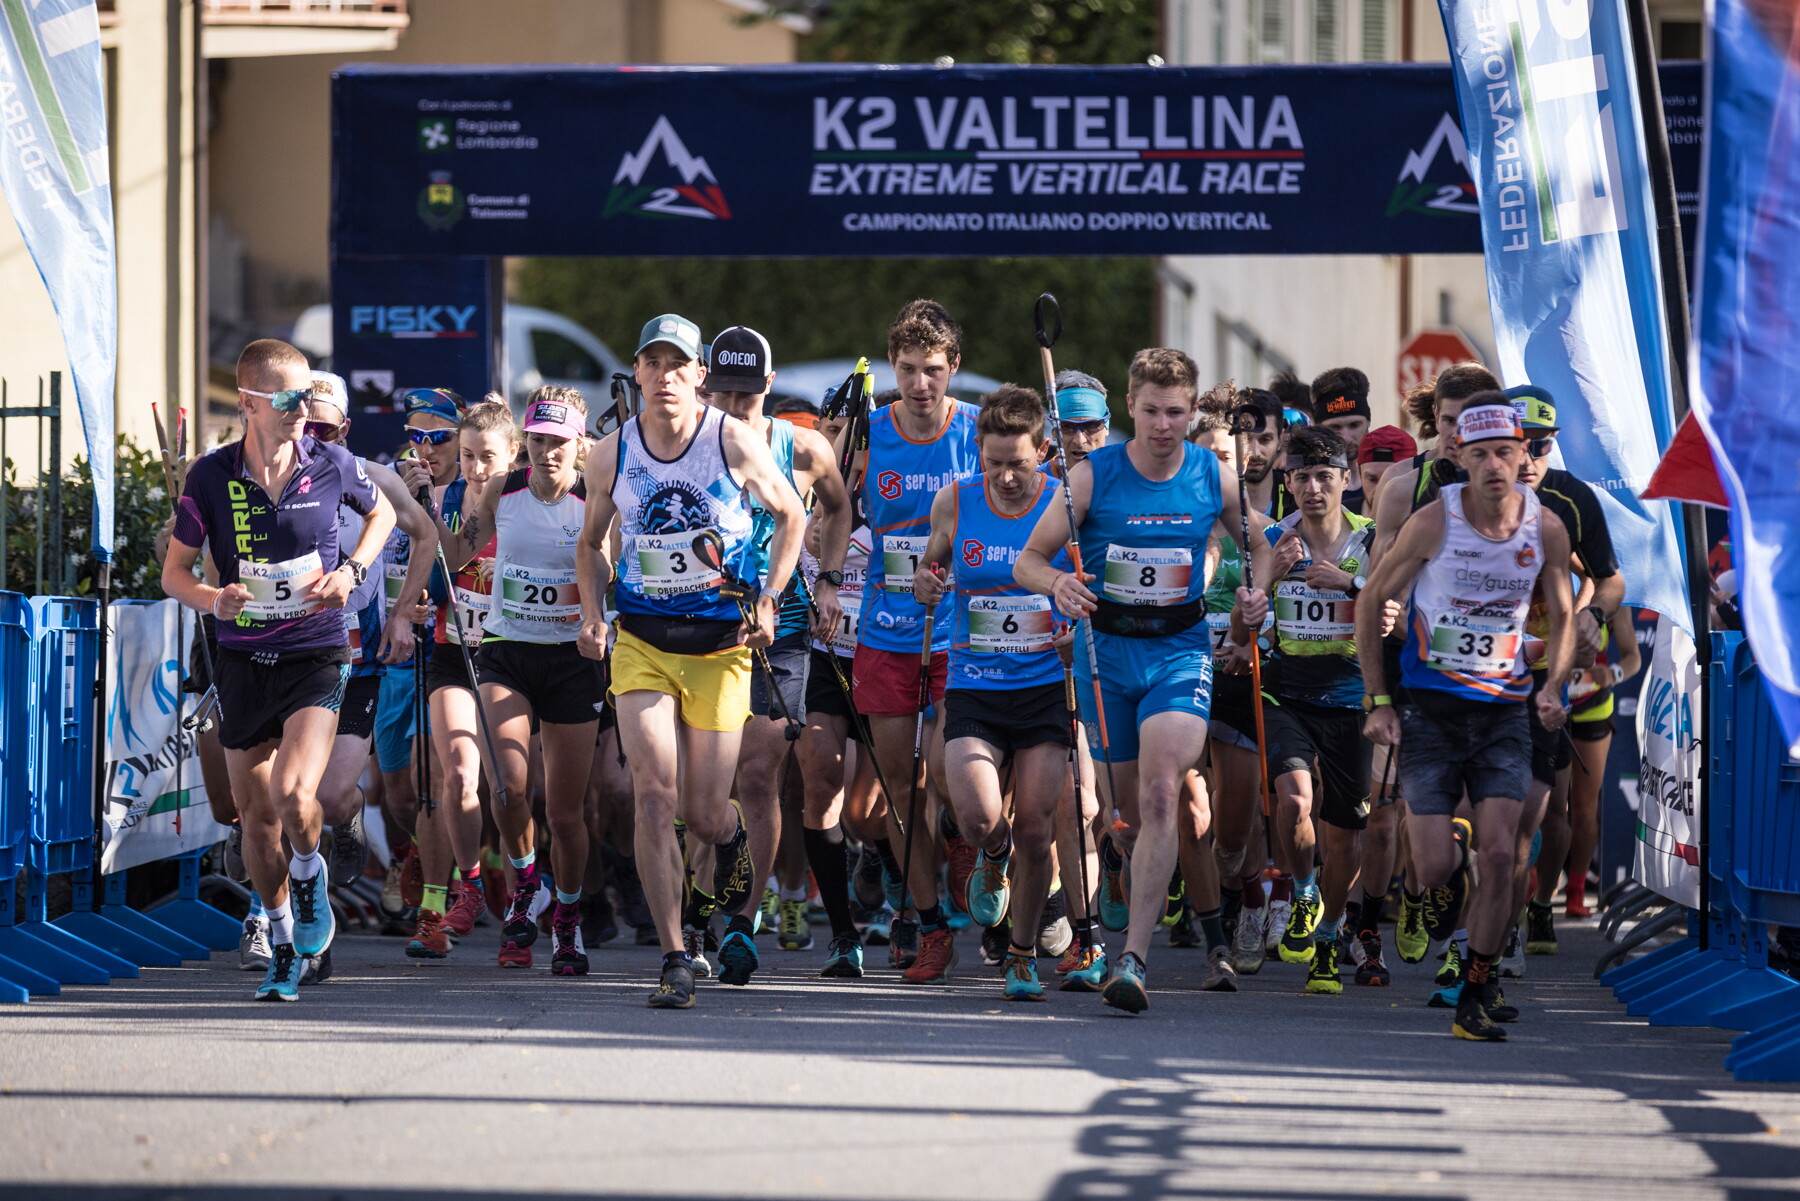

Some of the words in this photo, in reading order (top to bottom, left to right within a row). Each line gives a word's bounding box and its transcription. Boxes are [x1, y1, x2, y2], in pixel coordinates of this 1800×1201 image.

[456, 118, 521, 135] Regione
[813, 97, 896, 150] K2
[915, 96, 1305, 150] VALTELLINA
[456, 135, 538, 149] Lombardia
[809, 163, 998, 195] EXTREME
[1009, 162, 1188, 195] VERTICAL
[1200, 162, 1305, 194] RACE
[843, 213, 984, 231] CAMPIONATO
[988, 213, 1084, 231] ITALIANO
[1088, 213, 1169, 231] DOPPIO
[1171, 212, 1272, 231] VERTICAL
[351, 305, 477, 332] FISKY
[905, 473, 925, 491] ser
[649, 540, 663, 549] K2
[897, 541, 910, 550] K2
[987, 545, 1007, 561] ser
[1122, 551, 1138, 561] K2
[670, 552, 688, 574] 3
[253, 567, 267, 577] K2
[266, 564, 313, 580] VALTELLINA
[516, 569, 529, 580] K2
[528, 577, 571, 585] VALTELLINA
[1140, 566, 1156, 587] 8
[275, 580, 292, 601] 5
[524, 584, 558, 606] 20
[657, 582, 711, 594] OBERBACHER
[1291, 586, 1306, 596] K2
[1304, 592, 1347, 600] VALTELLINA
[460, 592, 470, 603] K2
[284, 609, 307, 618] PERO
[983, 600, 997, 610] K2
[996, 604, 1041, 612] VALTELLINA
[1293, 600, 1336, 622] 101
[515, 612, 524, 620] DE
[527, 614, 567, 623] SILVESTRO
[1002, 614, 1019, 634] 6
[1452, 616, 1468, 627] K2
[1467, 623, 1510, 633] VALTELLIN
[1297, 633, 1333, 641] CURTONI
[1458, 632, 1494, 657] 33
